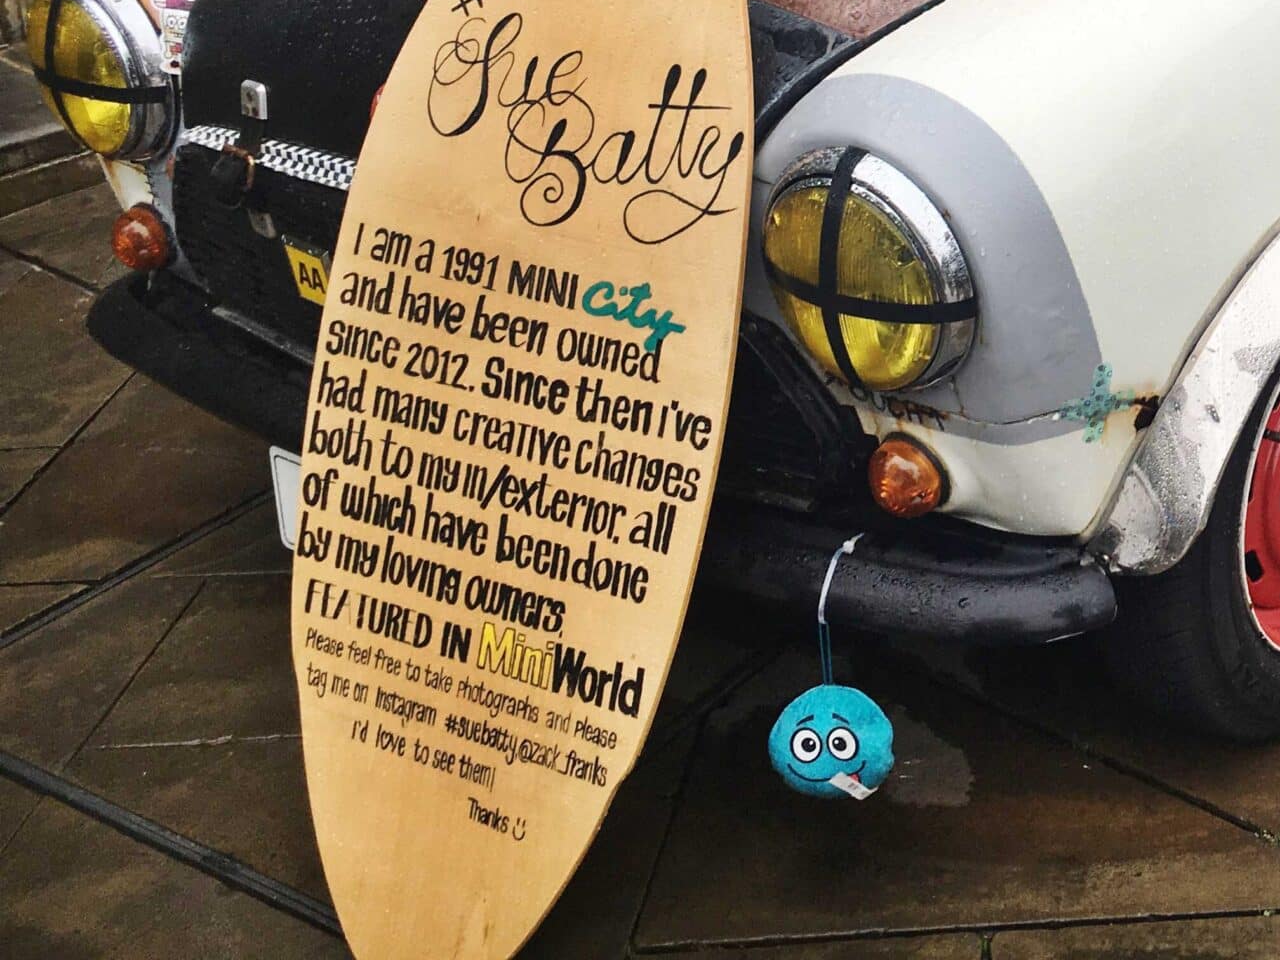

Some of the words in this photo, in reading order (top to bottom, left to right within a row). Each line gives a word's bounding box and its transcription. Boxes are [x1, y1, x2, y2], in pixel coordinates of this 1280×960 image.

[427, 12, 588, 138] Sue
[505, 64, 745, 245] Batty
[298, 262, 327, 295] AA
[340, 271, 396, 316] and
[399, 276, 466, 334] have
[470, 295, 549, 356] been
[557, 327, 664, 383] owned
[353, 223, 365, 256] I
[370, 227, 414, 267] am
[415, 238, 435, 273] a
[440, 245, 501, 291] 1991
[507, 260, 579, 310] MINI
[581, 281, 687, 351] City
[317, 361, 368, 414] had
[372, 384, 449, 435] many
[453, 407, 569, 470] creative
[575, 431, 701, 502] changes
[403, 342, 475, 393] 2012.
[481, 356, 570, 415] Since
[574, 376, 654, 433] then
[308, 409, 373, 471] both
[380, 428, 414, 480] to
[417, 451, 461, 493] my
[630, 501, 677, 555] all
[297, 511, 333, 563] by
[335, 525, 379, 578] my
[380, 536, 463, 605] loving
[302, 468, 339, 508] of
[341, 476, 416, 538] which
[421, 492, 489, 557] have
[495, 515, 573, 585] been
[572, 541, 650, 605] done
[304, 578, 434, 650] FEATURED
[440, 621, 473, 663] IN
[305, 627, 345, 659] Please
[347, 642, 373, 666] feel
[374, 649, 402, 677] free
[405, 658, 422, 683] to
[424, 668, 454, 696] take
[546, 709, 572, 735] and
[306, 661, 329, 698] tag
[331, 675, 351, 698] me
[353, 683, 370, 705] on
[375, 723, 407, 757] love
[413, 737, 431, 767] to
[432, 749, 457, 775] see
[467, 796, 511, 834] Thanks
